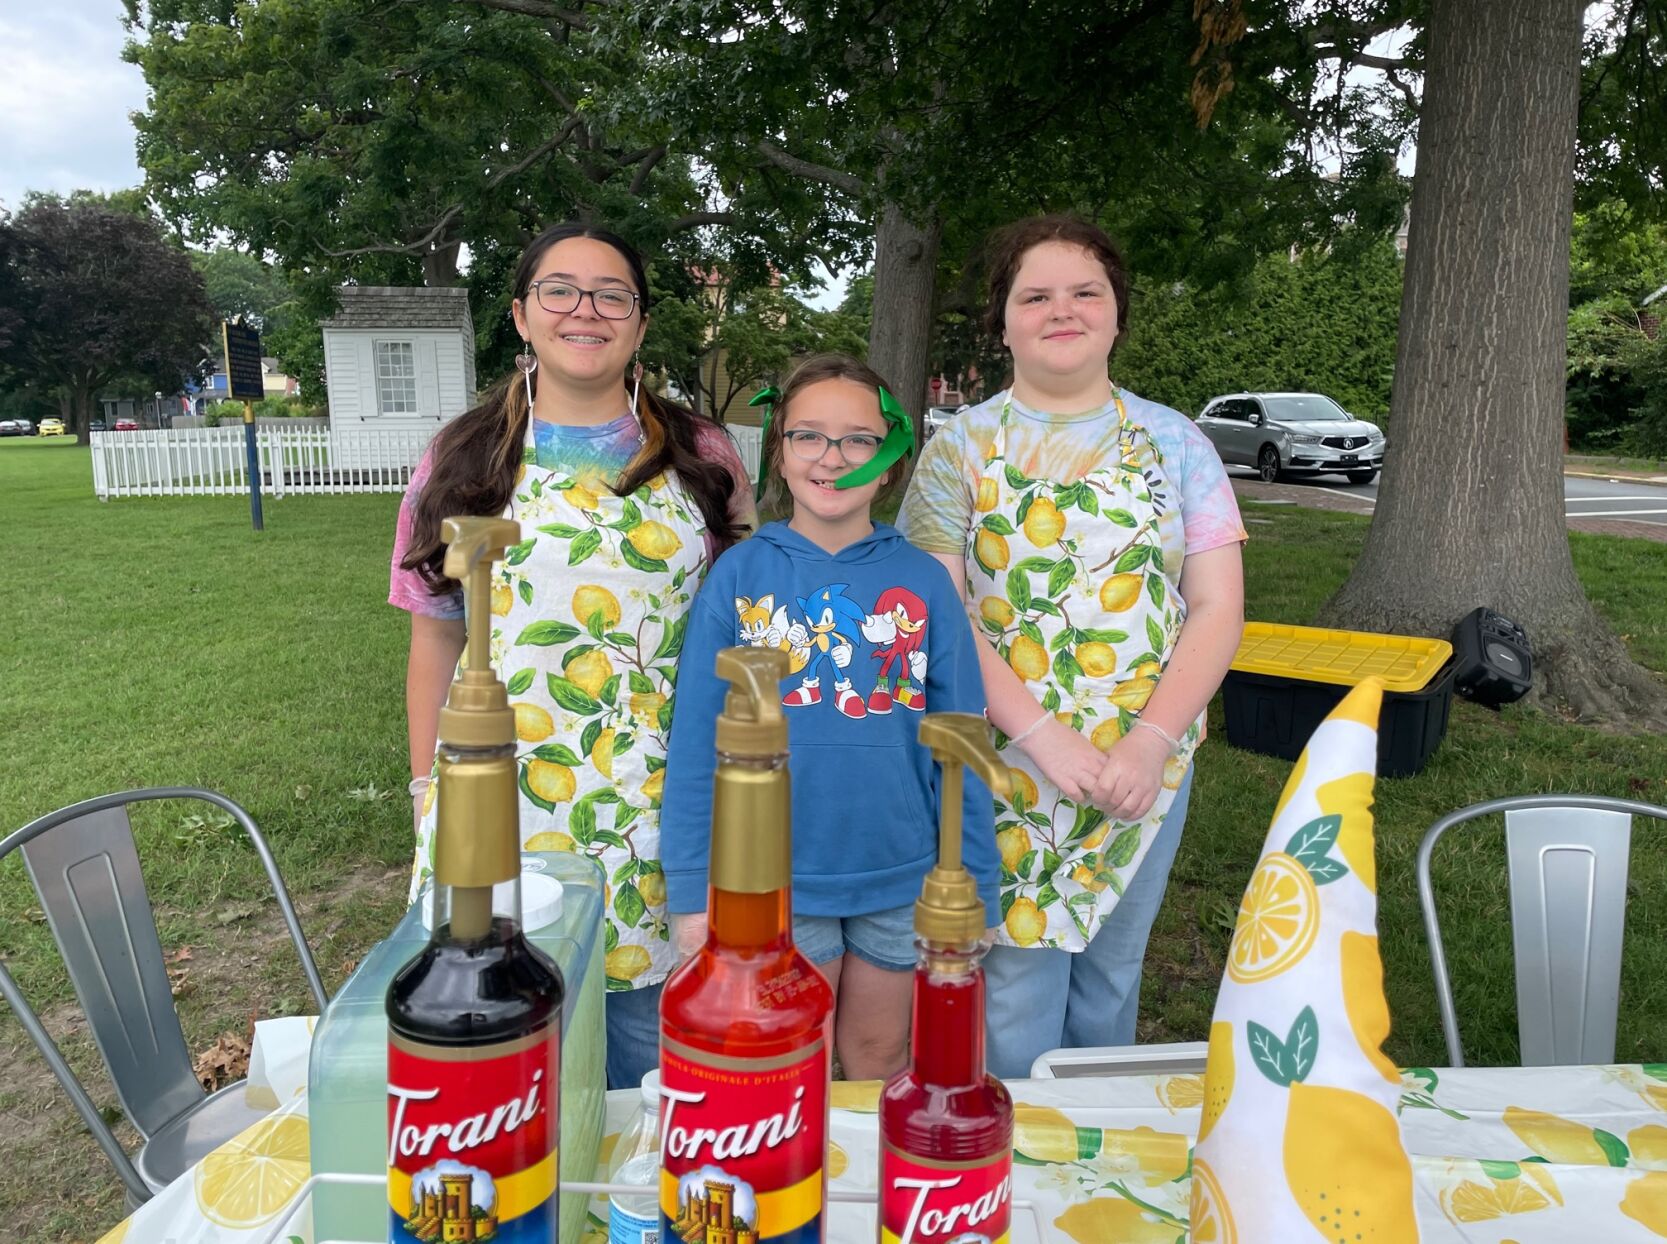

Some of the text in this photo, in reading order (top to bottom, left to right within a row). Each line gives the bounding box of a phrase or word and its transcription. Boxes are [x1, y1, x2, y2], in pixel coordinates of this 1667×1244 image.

[387, 1069, 543, 1167] Torani
[659, 1085, 805, 1168] Torani
[893, 1174, 1011, 1244] Toran
